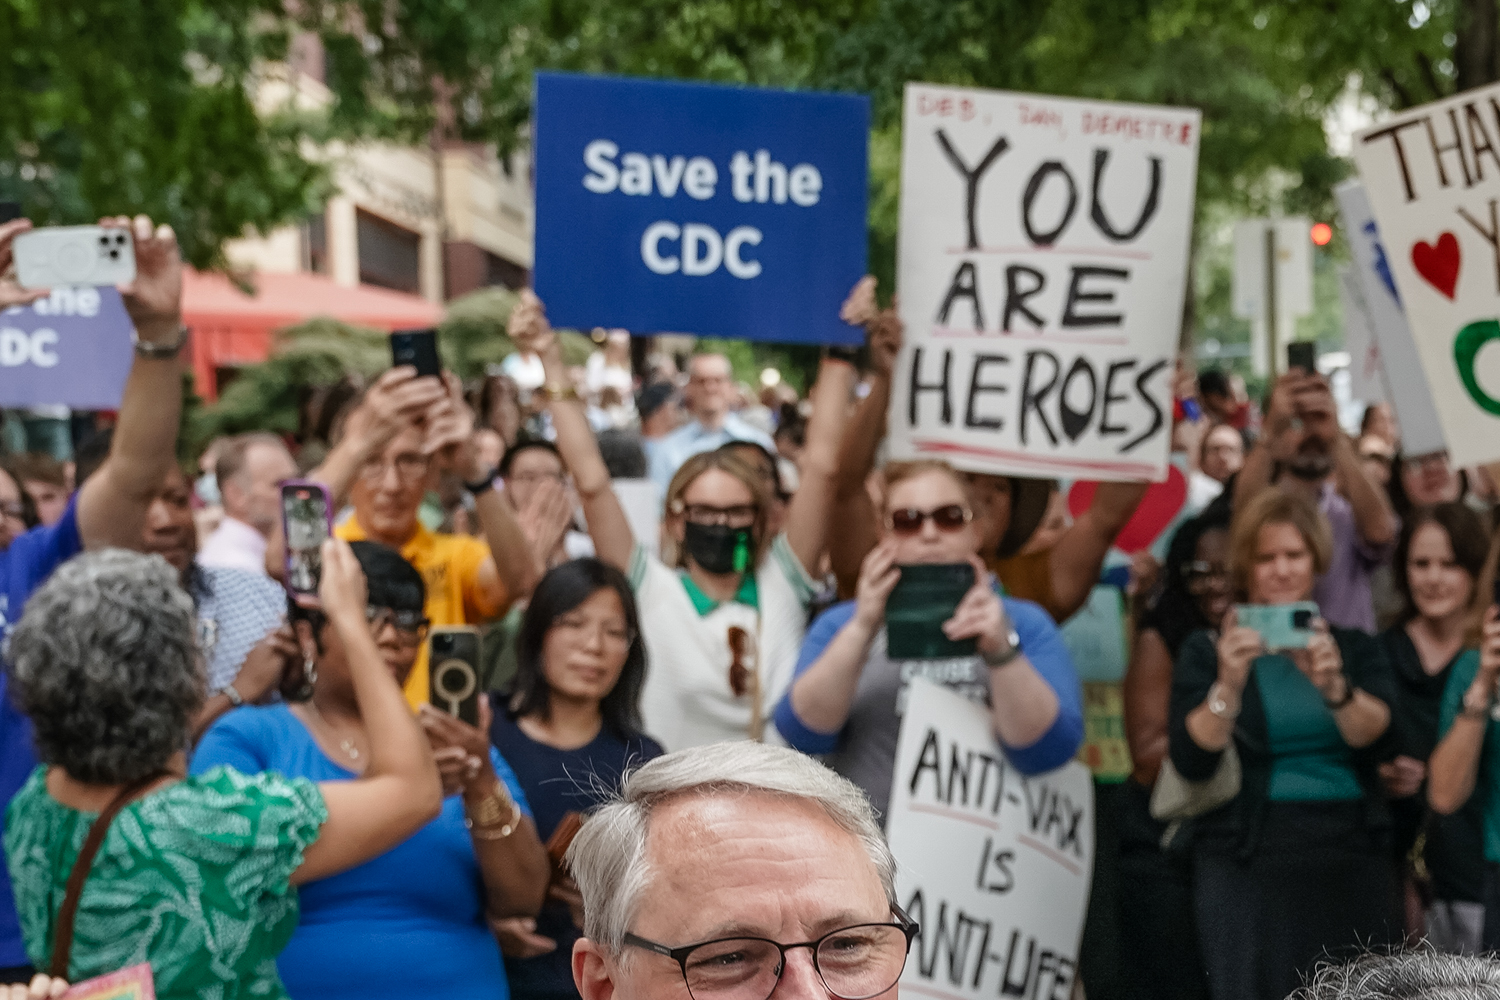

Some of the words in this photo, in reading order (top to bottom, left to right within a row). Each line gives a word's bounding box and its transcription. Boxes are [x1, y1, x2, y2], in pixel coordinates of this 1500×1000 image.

[582, 139, 718, 196] Save
[728, 149, 824, 206] the
[934, 127, 1163, 250] YOU
[640, 221, 764, 279] CDC
[936, 261, 1131, 334] ARE
[907, 347, 1171, 454] HEROES
[908, 727, 1086, 859] ANTI-VAX
[975, 837, 1016, 895] IS
